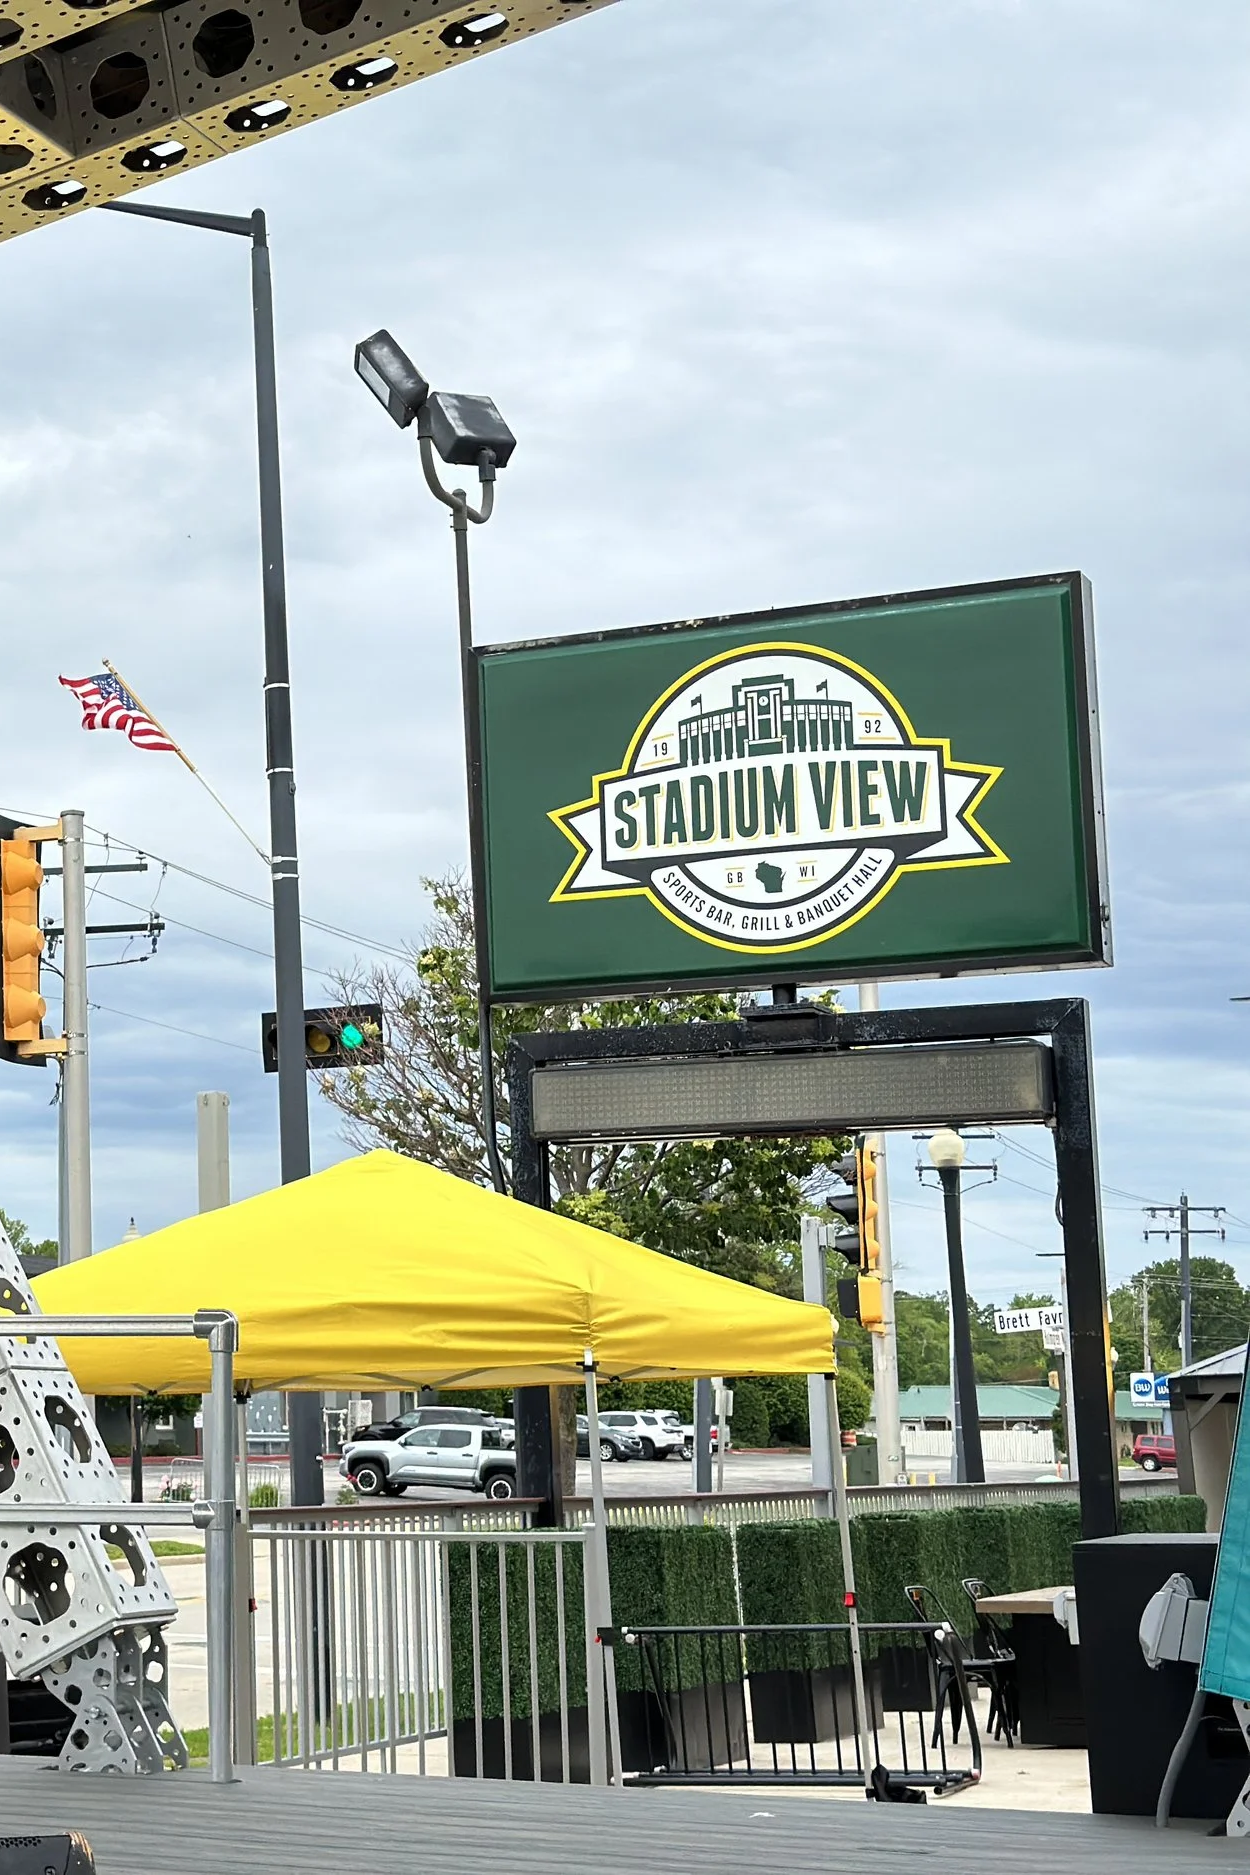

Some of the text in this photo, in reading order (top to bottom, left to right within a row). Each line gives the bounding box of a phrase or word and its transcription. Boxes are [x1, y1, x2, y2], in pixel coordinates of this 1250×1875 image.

[864, 719, 882, 734] 92
[653, 742, 668, 756] 19
[614, 760, 929, 849] STADIUM VIEW
[663, 856, 882, 931] SPORTS BAR, GRILL & BANQUET HALL
[998, 1310, 1063, 1330] Brett Favr
[1135, 1383, 1150, 1392] BW
